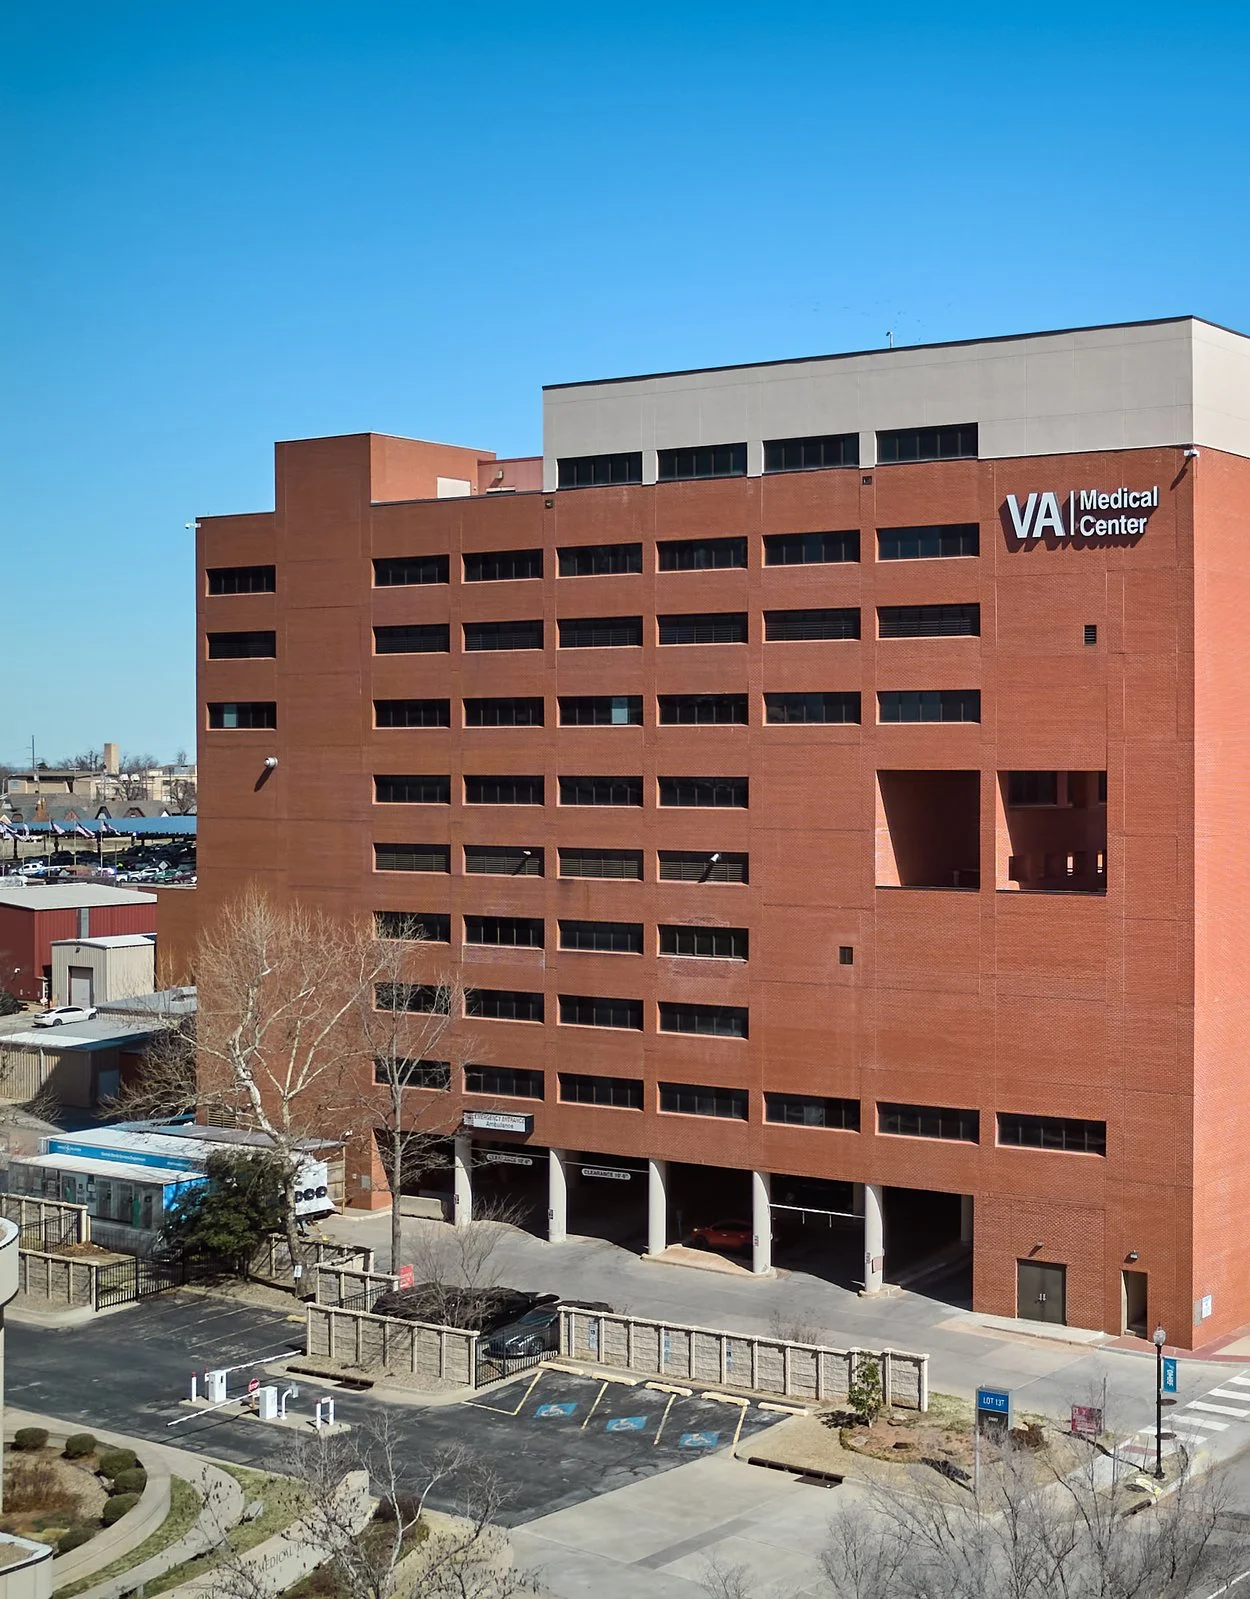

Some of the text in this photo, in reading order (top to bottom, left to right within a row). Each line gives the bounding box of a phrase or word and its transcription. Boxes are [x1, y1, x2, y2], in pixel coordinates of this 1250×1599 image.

[1080, 486, 1159, 511] Medical
[1006, 492, 1066, 538] VA
[1080, 514, 1147, 537] Center
[983, 1396, 1005, 1407] LOT 13T
